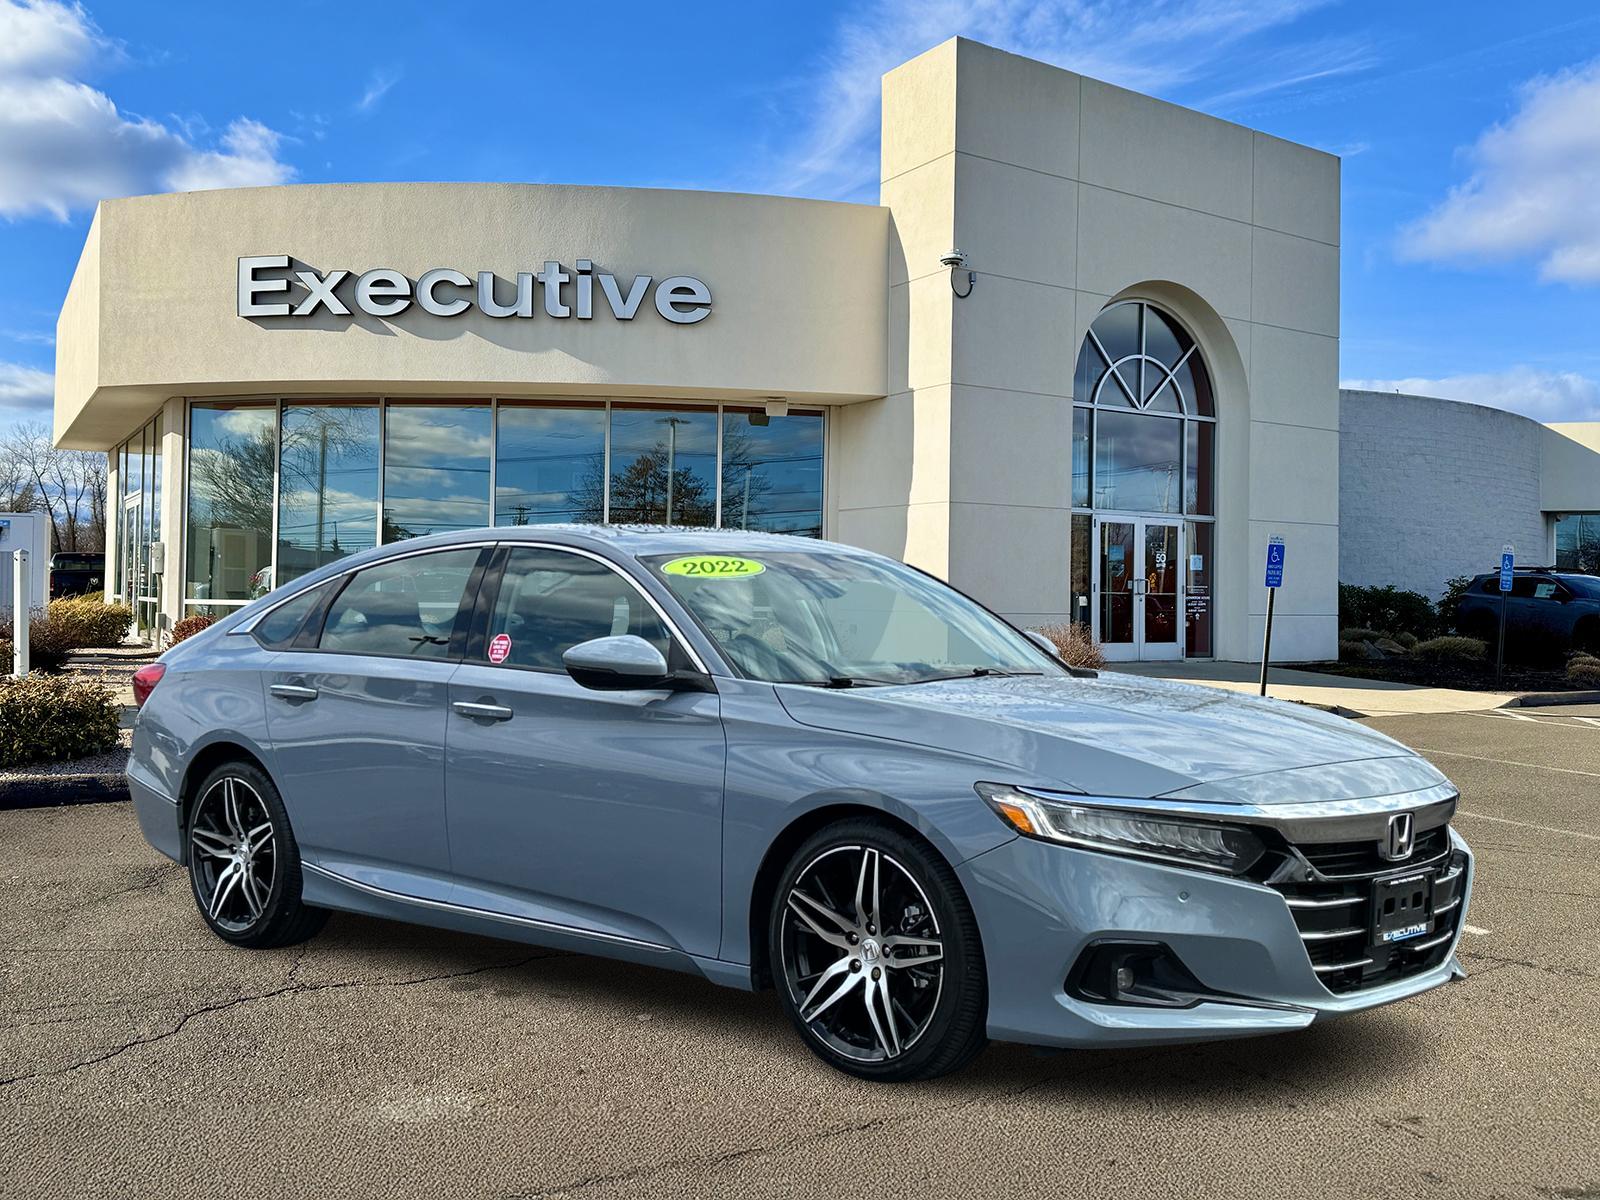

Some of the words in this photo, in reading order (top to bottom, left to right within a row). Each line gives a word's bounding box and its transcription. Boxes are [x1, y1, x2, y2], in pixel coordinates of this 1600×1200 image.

[237, 254, 712, 324] Executive
[1156, 553, 1166, 563] 50
[683, 560, 748, 575] 2022
[1383, 923, 1427, 941] EXECUTIVE
